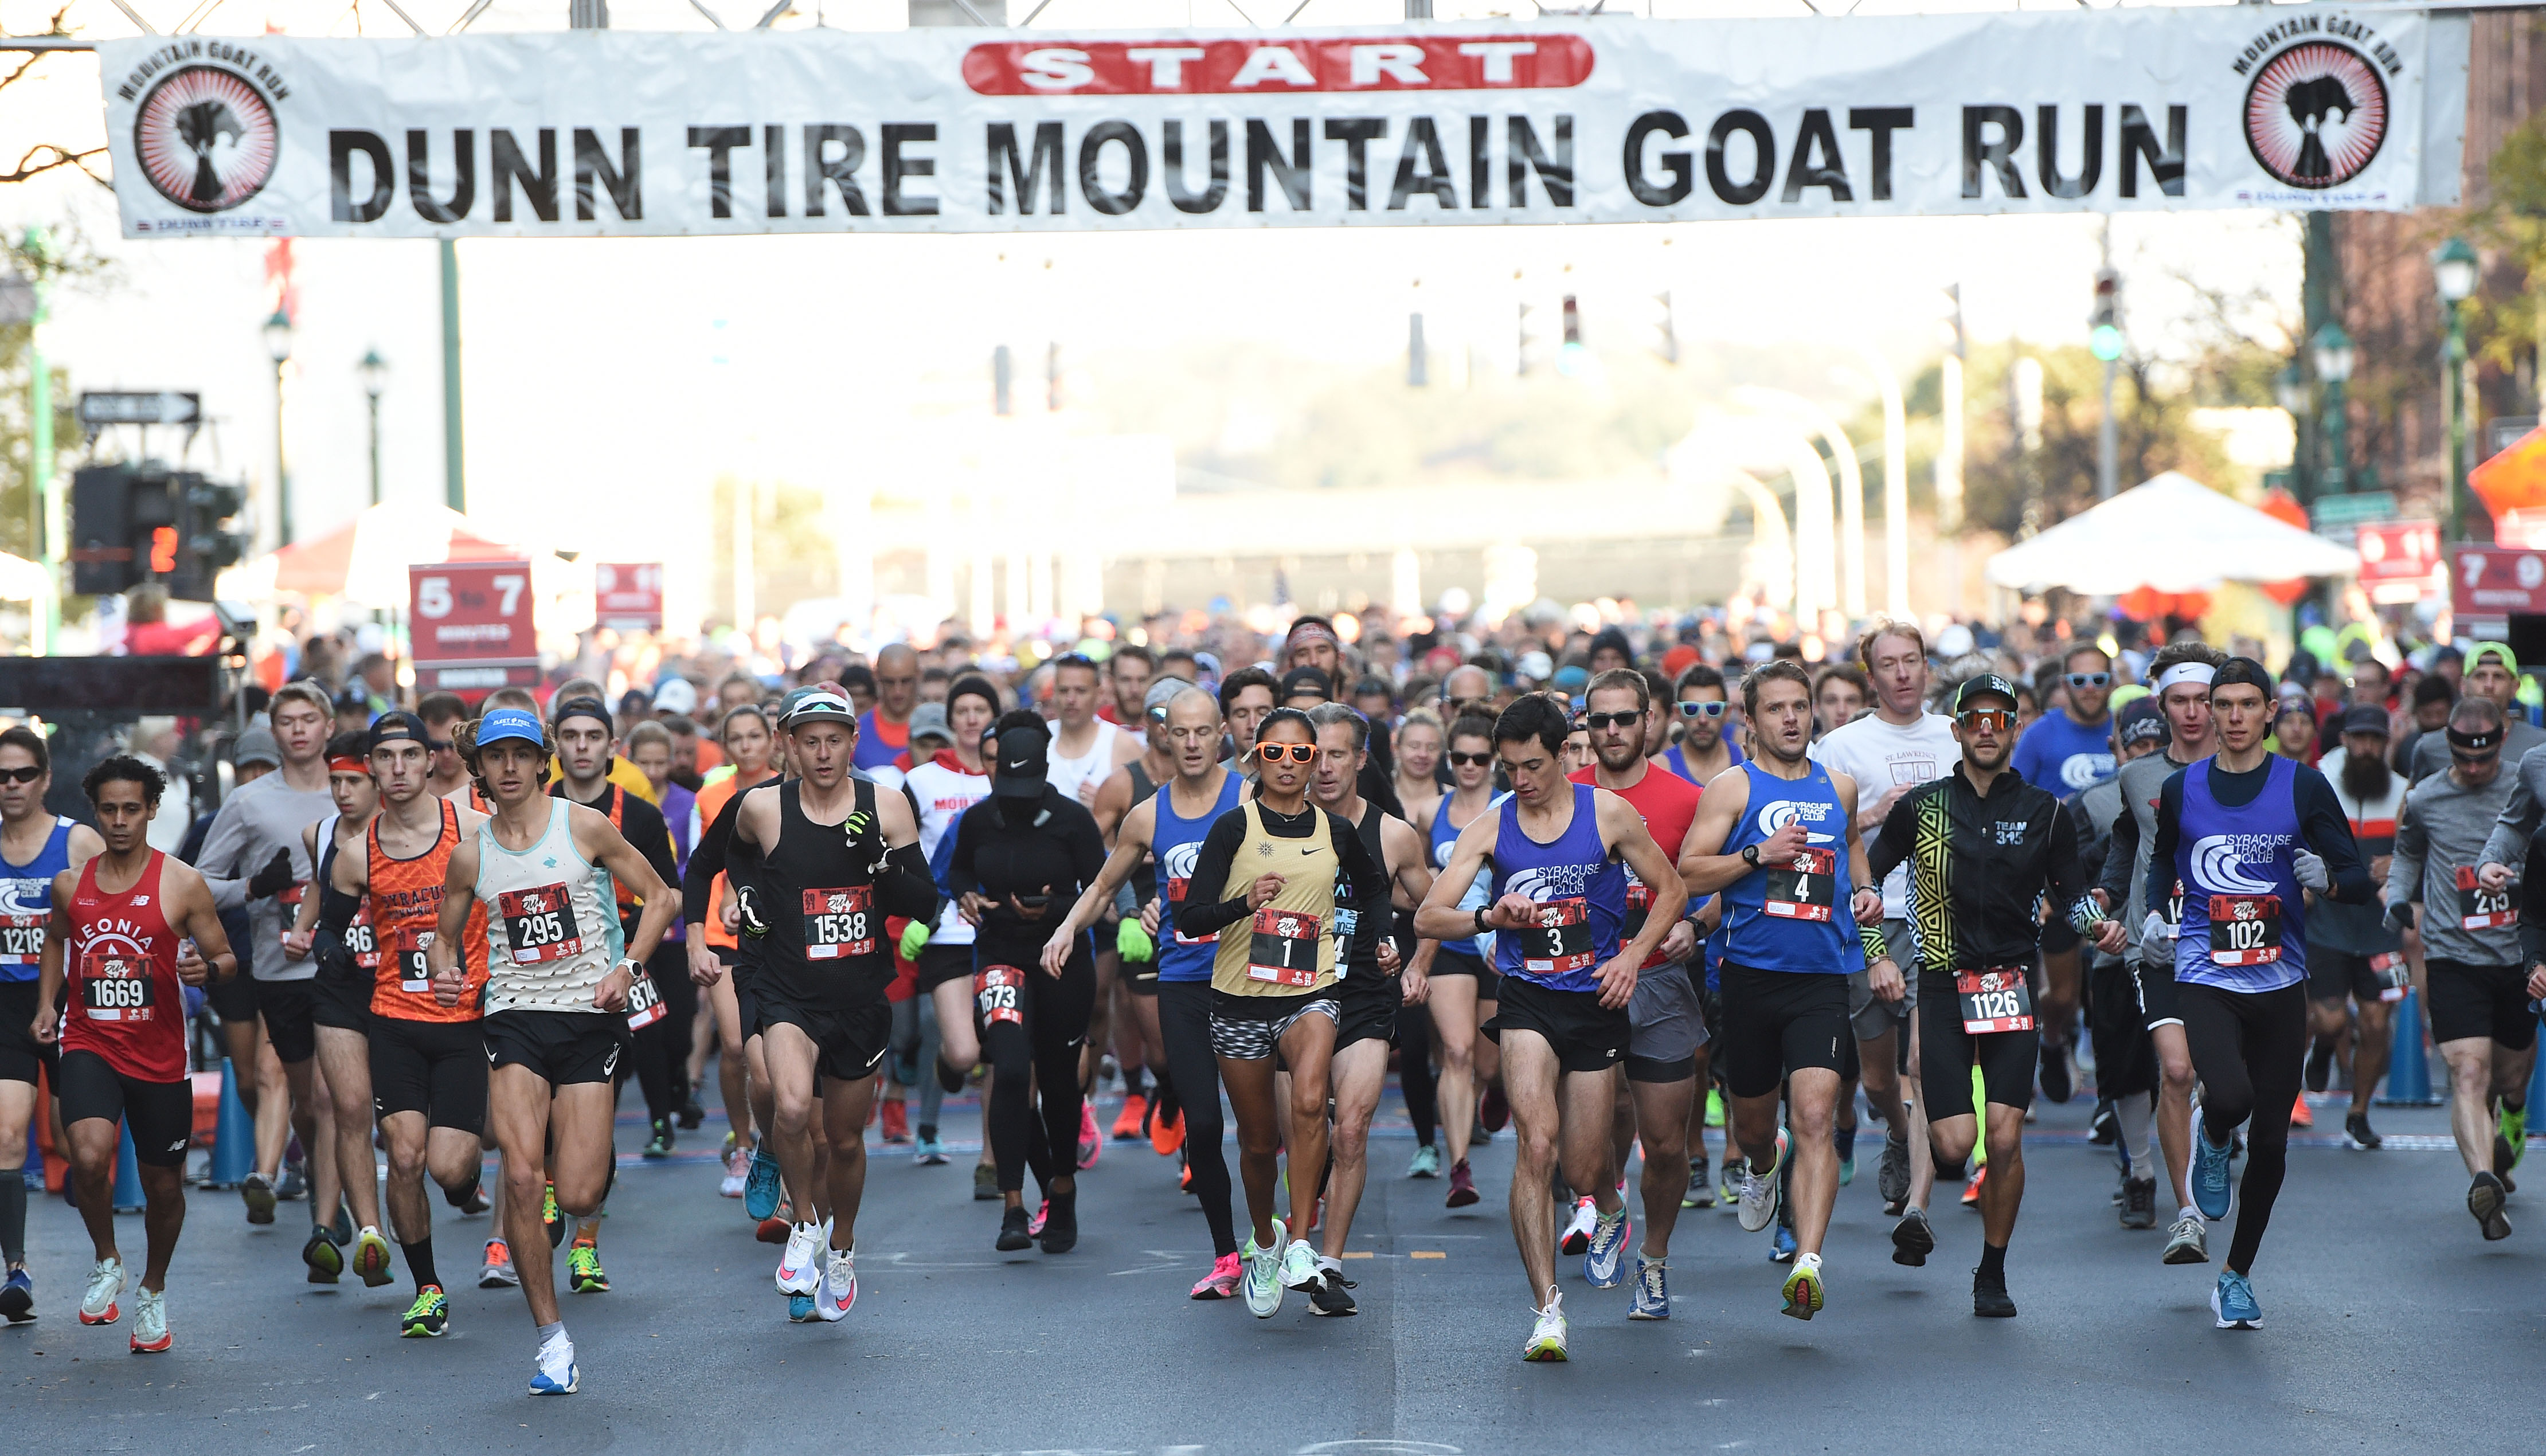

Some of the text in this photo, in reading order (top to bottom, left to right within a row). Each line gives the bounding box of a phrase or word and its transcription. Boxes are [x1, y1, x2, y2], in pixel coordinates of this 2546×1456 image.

[2233, 15, 2403, 77] MOUNTAIN GOAT RUN
[118, 40, 290, 101] MOUNTAIN GOAT RUN
[1019, 42, 1537, 89] START
[328, 103, 2188, 223] DUNN TIRE MOUNTAIN GOAT RUN
[2461, 554, 2487, 588] 7
[419, 577, 453, 619] 5
[493, 574, 525, 617] 7
[518, 719, 531, 727] FEET
[1790, 801, 1833, 810] SYRACUSE
[1995, 821, 2027, 831] TEAM
[1996, 831, 2023, 845] 315
[2227, 834, 2293, 846] SYRACUSE
[2234, 844, 2274, 854] TRACK
[1538, 863, 1601, 878] SYRACUSE
[2242, 854, 2274, 864] CLUB
[1546, 874, 1586, 886] TRACK
[1554, 883, 1585, 895] CLUB
[1795, 874, 1809, 902] 4
[554, 886, 569, 908] 10
[805, 902, 815, 910] 21
[1536, 900, 1570, 911] OUNTAIN
[1272, 911, 1309, 922] MOUNTAIN
[1346, 909, 1358, 935] RELAY
[1573, 902, 1589, 923] 10
[3, 927, 44, 954] 1218
[74, 918, 152, 949] LEONIA
[519, 912, 563, 946] 295
[814, 913, 866, 944] 1538
[1336, 921, 1345, 933] 10
[2227, 920, 2265, 949] 102
[1282, 940, 1292, 967] 1
[1547, 928, 1563, 956] 3
[92, 980, 143, 1007] 1669
[628, 979, 658, 1012] 874
[979, 985, 1016, 1013] 1673
[1971, 991, 2019, 1019] 1126
